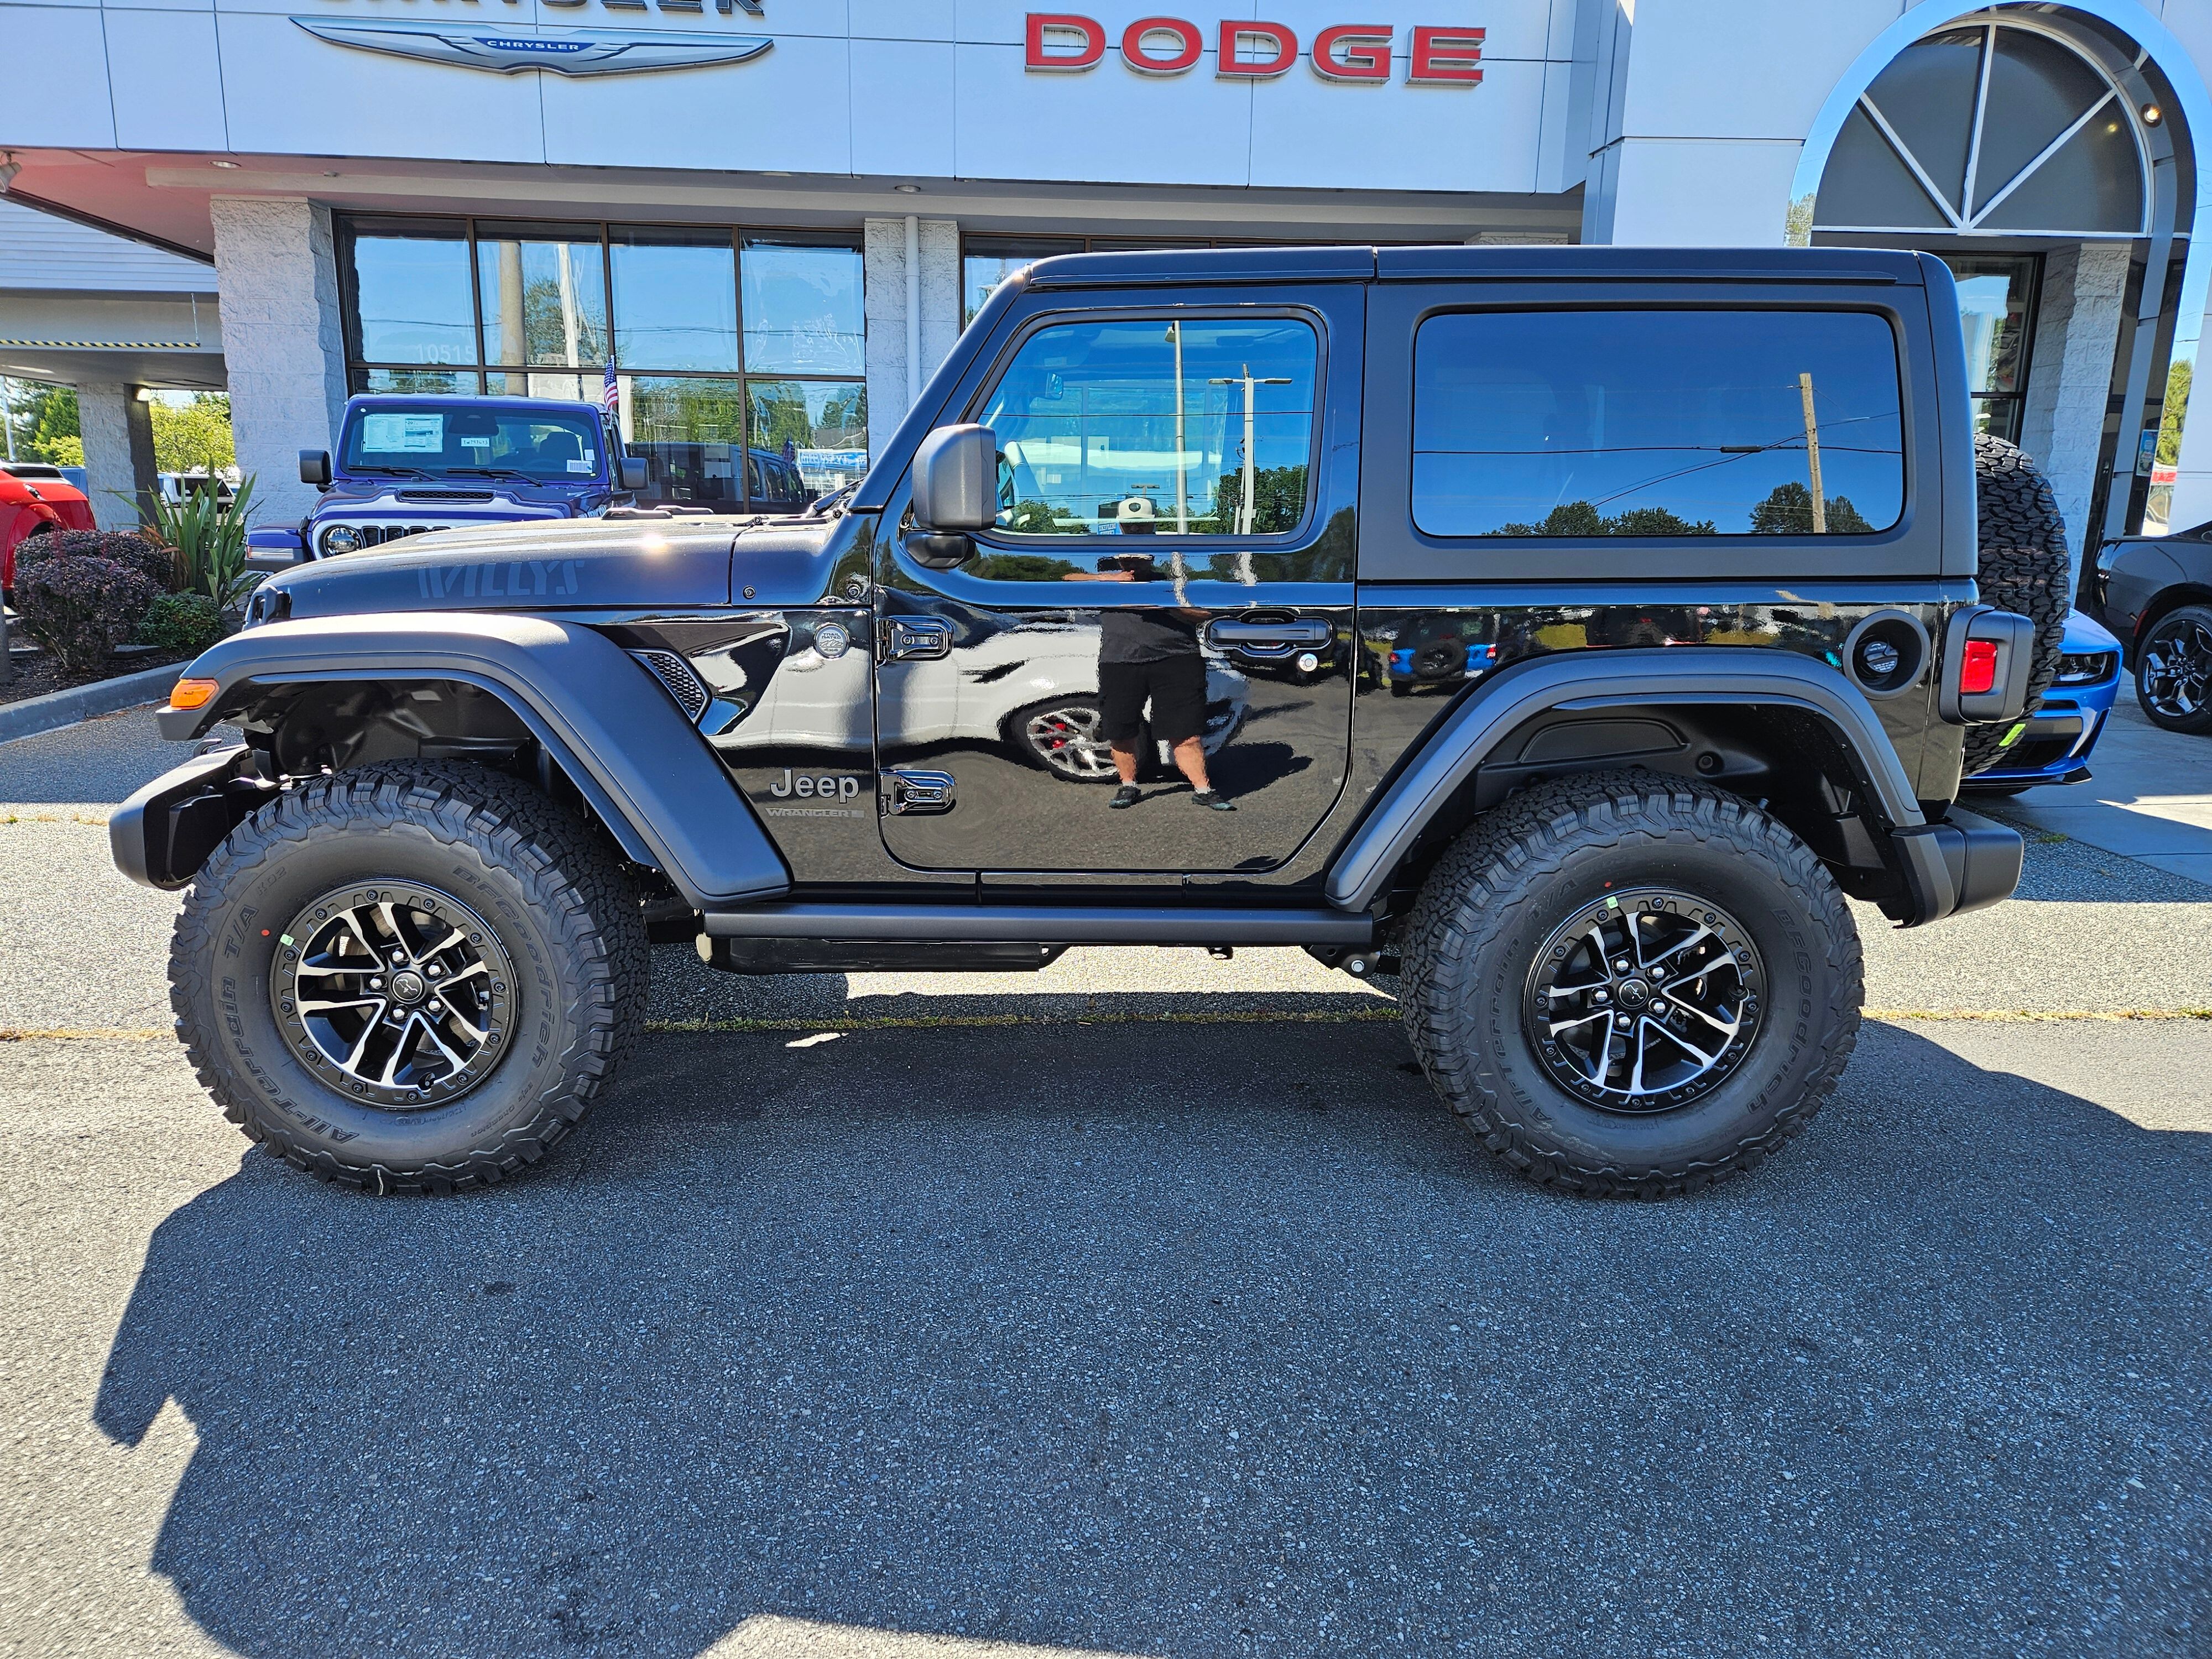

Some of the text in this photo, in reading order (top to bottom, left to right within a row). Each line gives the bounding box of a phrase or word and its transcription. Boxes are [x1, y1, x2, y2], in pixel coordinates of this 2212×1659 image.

[487, 40, 579, 50] CHRYSLER
[1024, 12, 1485, 86] DODGE
[416, 343, 475, 364] 10515
[418, 560, 585, 598] WILLYS
[765, 808, 849, 817] WRANGLER
[770, 768, 859, 804] Jeep
[224, 904, 259, 959] T/A
[452, 865, 556, 1068] BFGoodrich
[1490, 936, 1556, 1124] All-Terrain
[1746, 908, 1812, 1114] BFGoodrich
[219, 976, 360, 1144] All-Terrain
